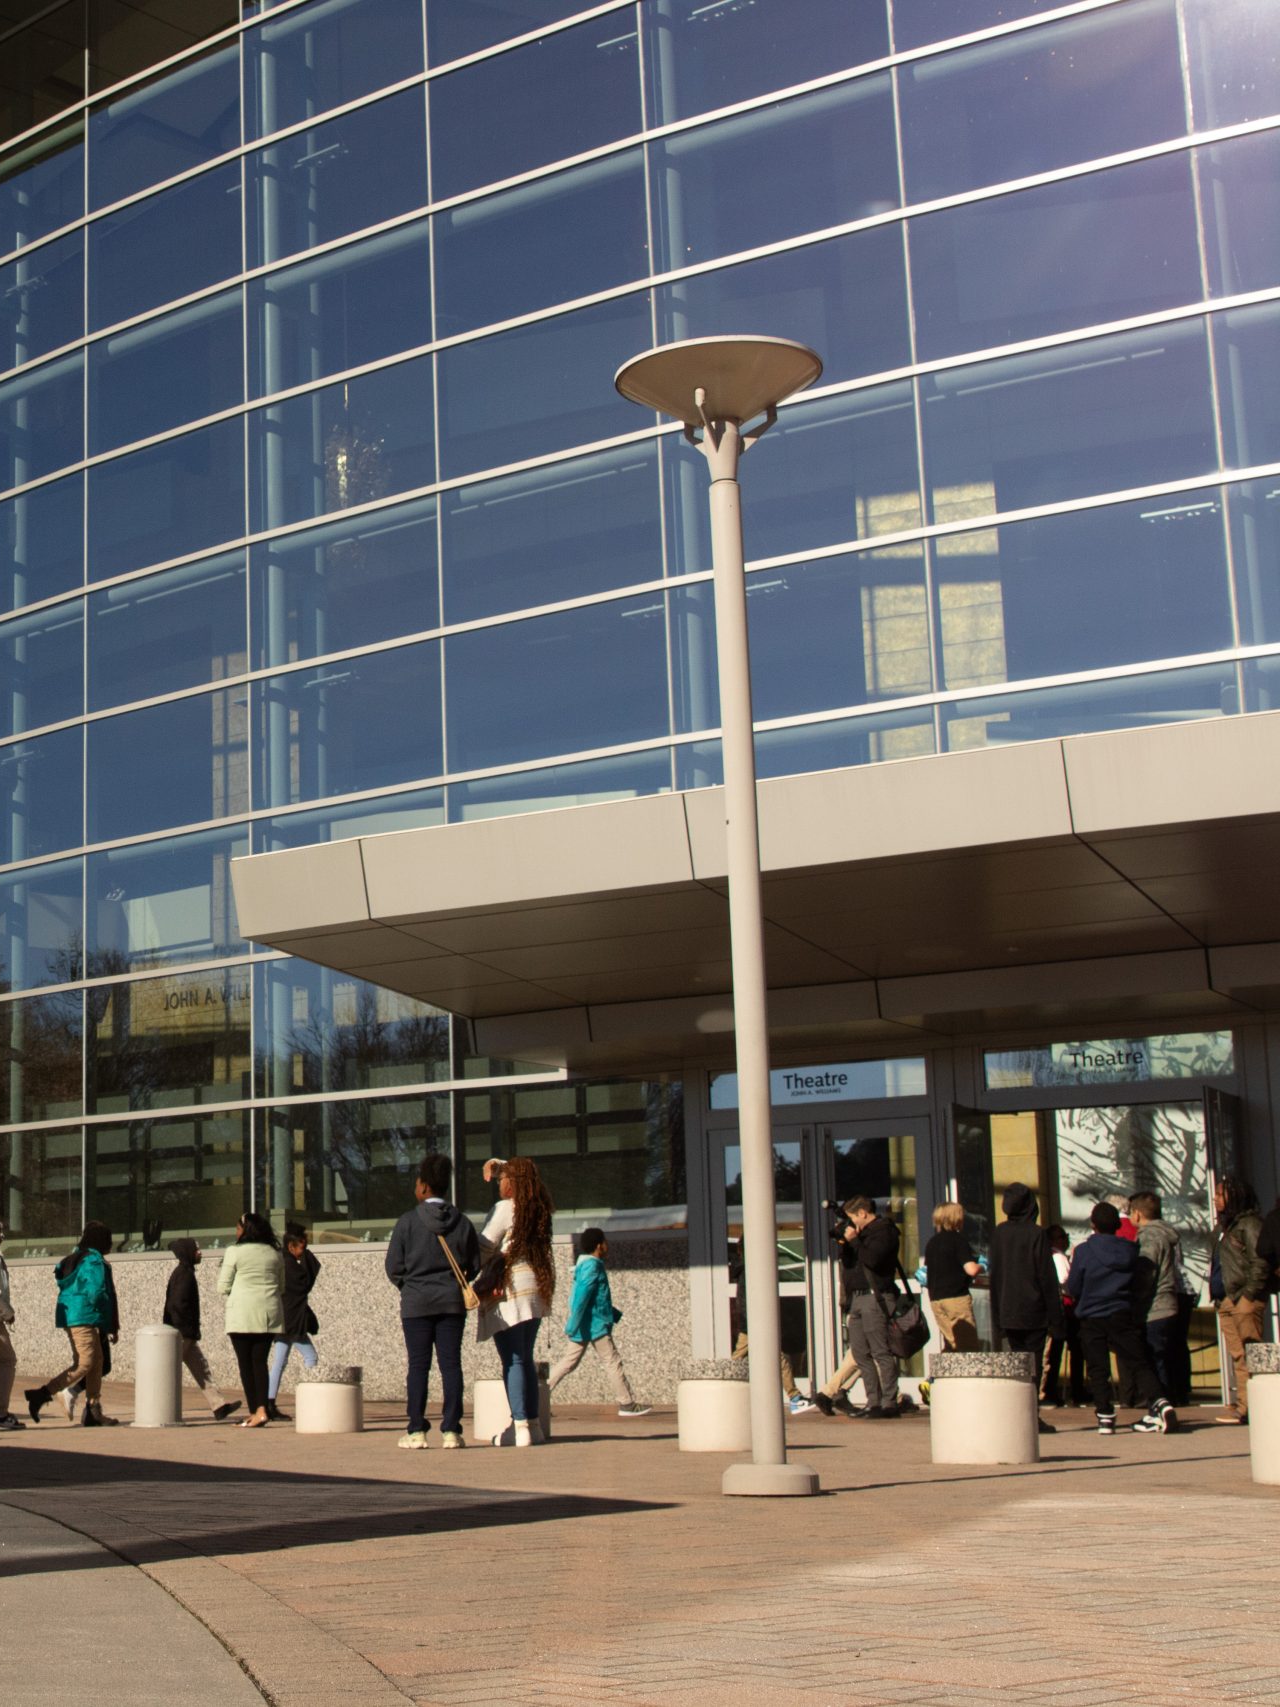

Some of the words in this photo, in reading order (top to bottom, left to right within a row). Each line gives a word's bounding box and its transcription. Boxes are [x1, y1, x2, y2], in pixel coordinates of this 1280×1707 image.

[163, 988, 199, 1011] JOHN
[1070, 1050, 1143, 1068] Theatre
[783, 1072, 848, 1090] Theatre
